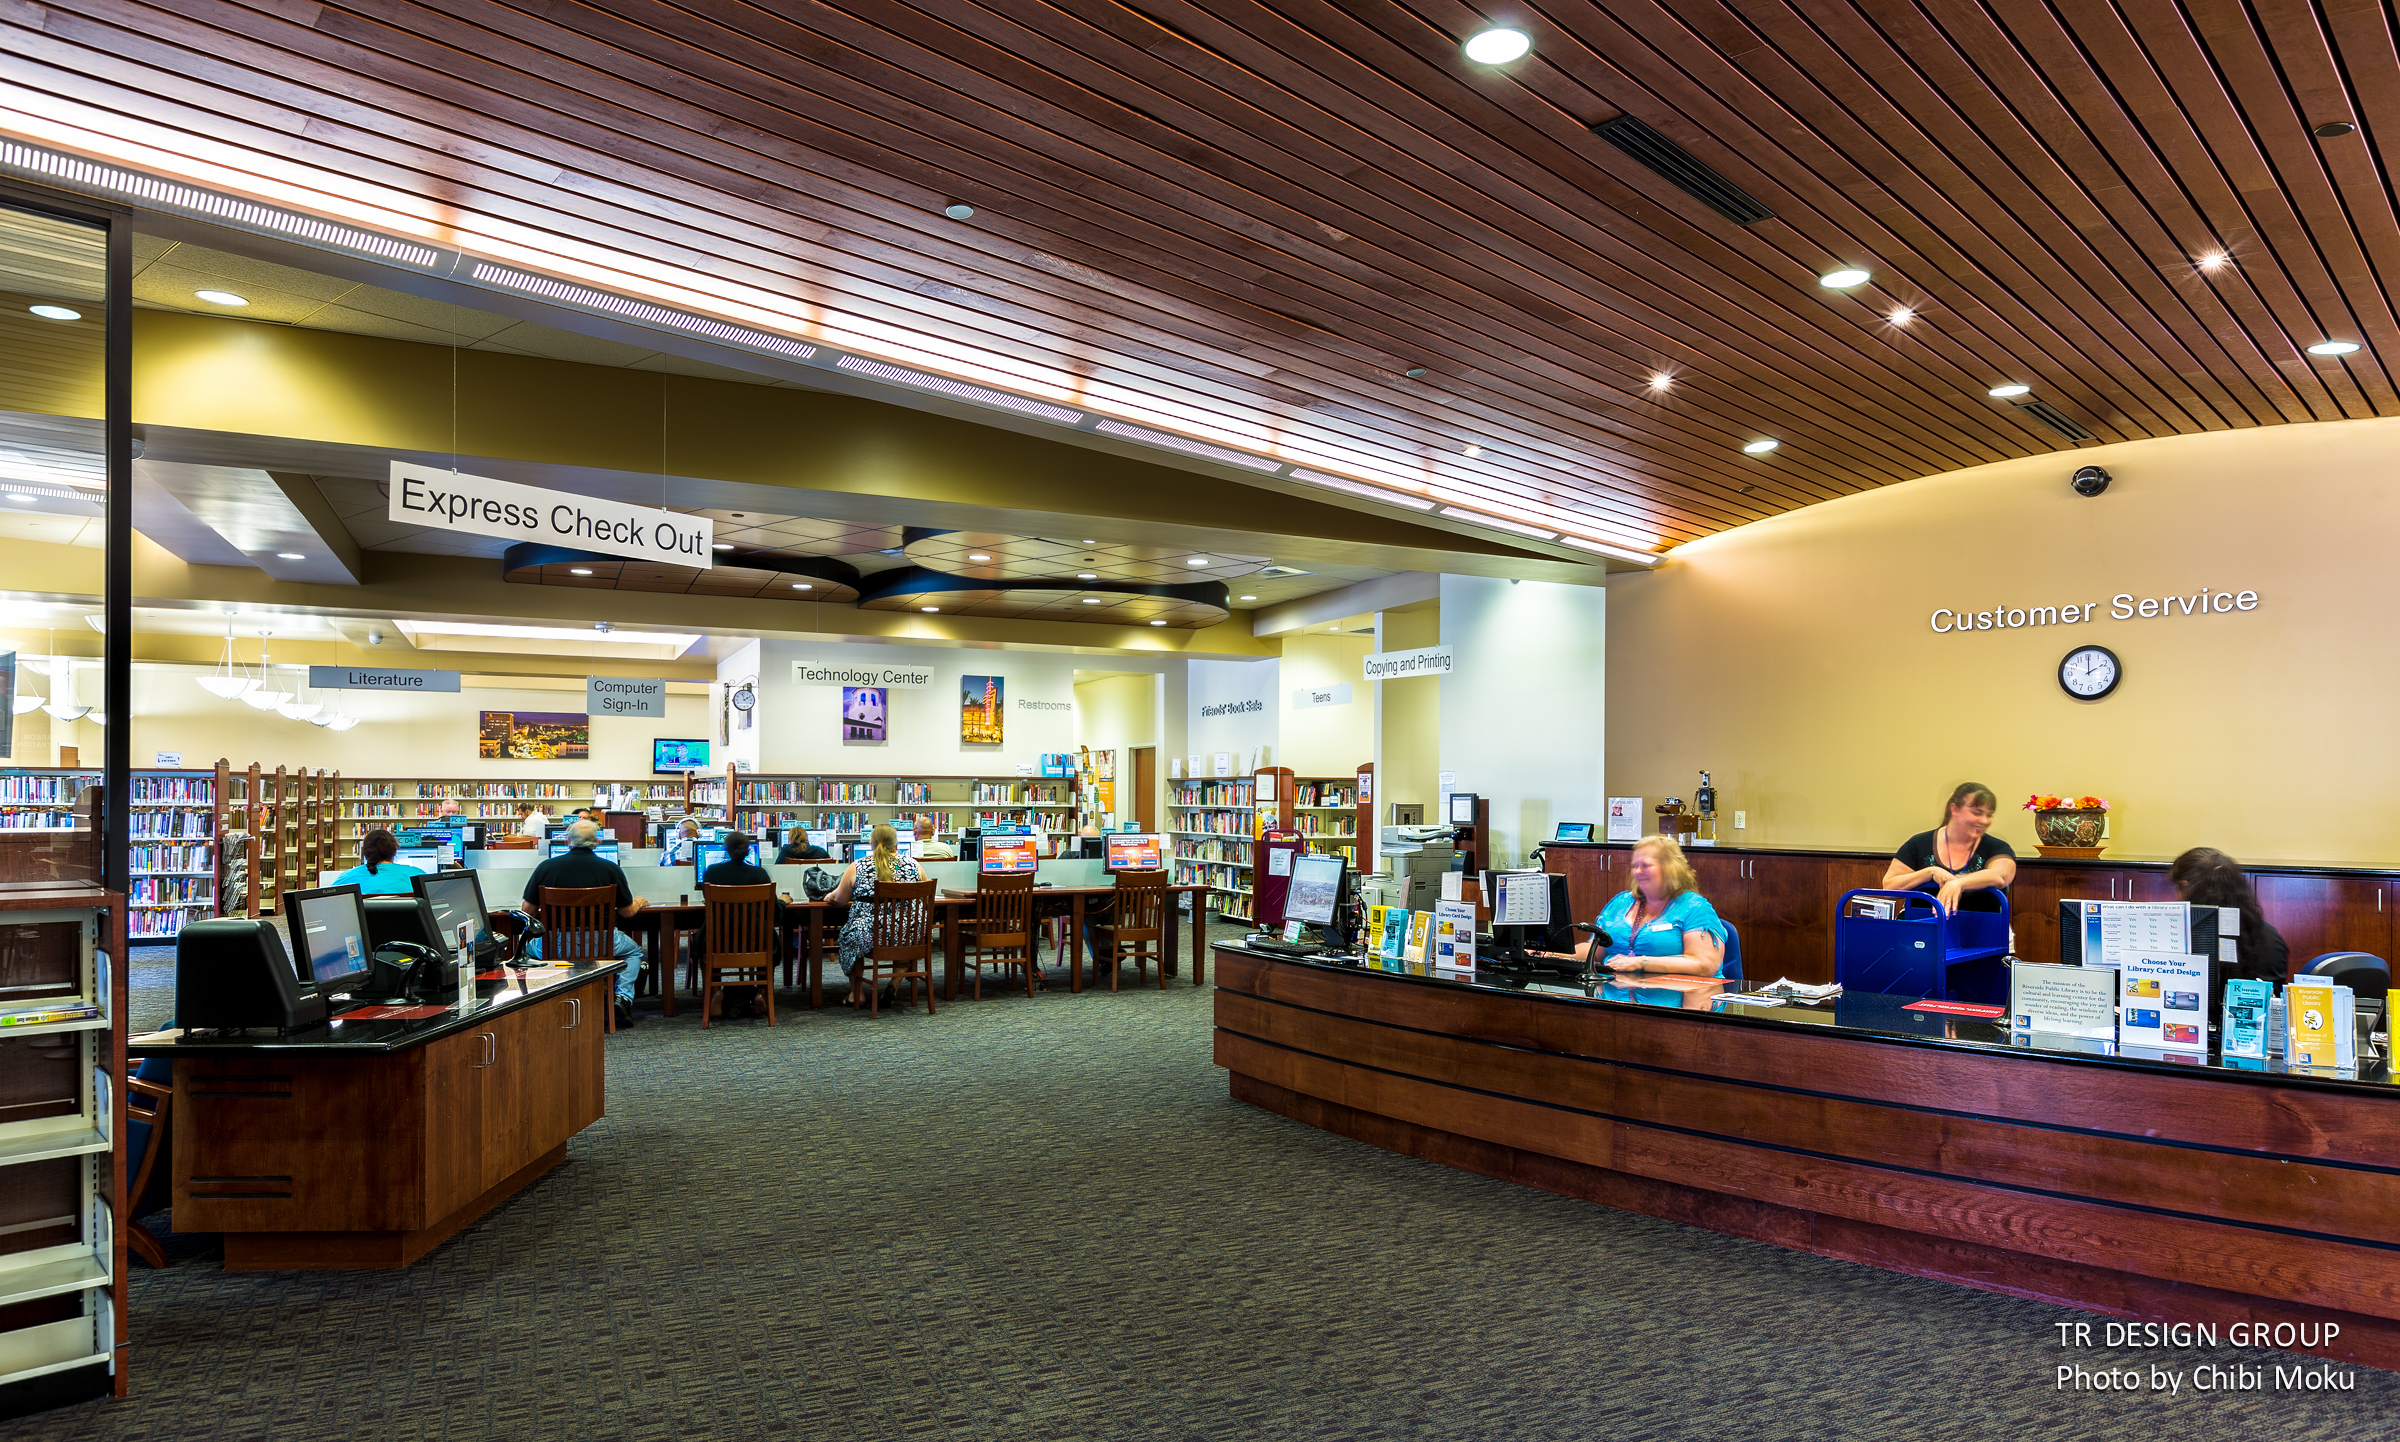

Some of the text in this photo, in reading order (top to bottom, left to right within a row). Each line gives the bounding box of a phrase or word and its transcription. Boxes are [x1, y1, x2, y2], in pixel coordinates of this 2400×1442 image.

[402, 477, 704, 556] Express Check Out
[1930, 587, 2259, 633] Customer Service
[1366, 652, 1451, 677] Copying and Printing
[349, 672, 423, 686] Literature
[798, 666, 928, 685] Technology Center
[594, 680, 658, 696] Computer
[1312, 692, 1331, 703] Teens
[602, 698, 648, 712] Sign-In
[1018, 699, 1072, 711] Restrooms
[1228, 701, 1245, 714] Book
[1246, 700, 1262, 711] Sale
[2127, 965, 2154, 974] Library
[2176, 968, 2201, 977] Design
[2234, 984, 2259, 992] Riverside
[2062, 1017, 2083, 1025] learning.
